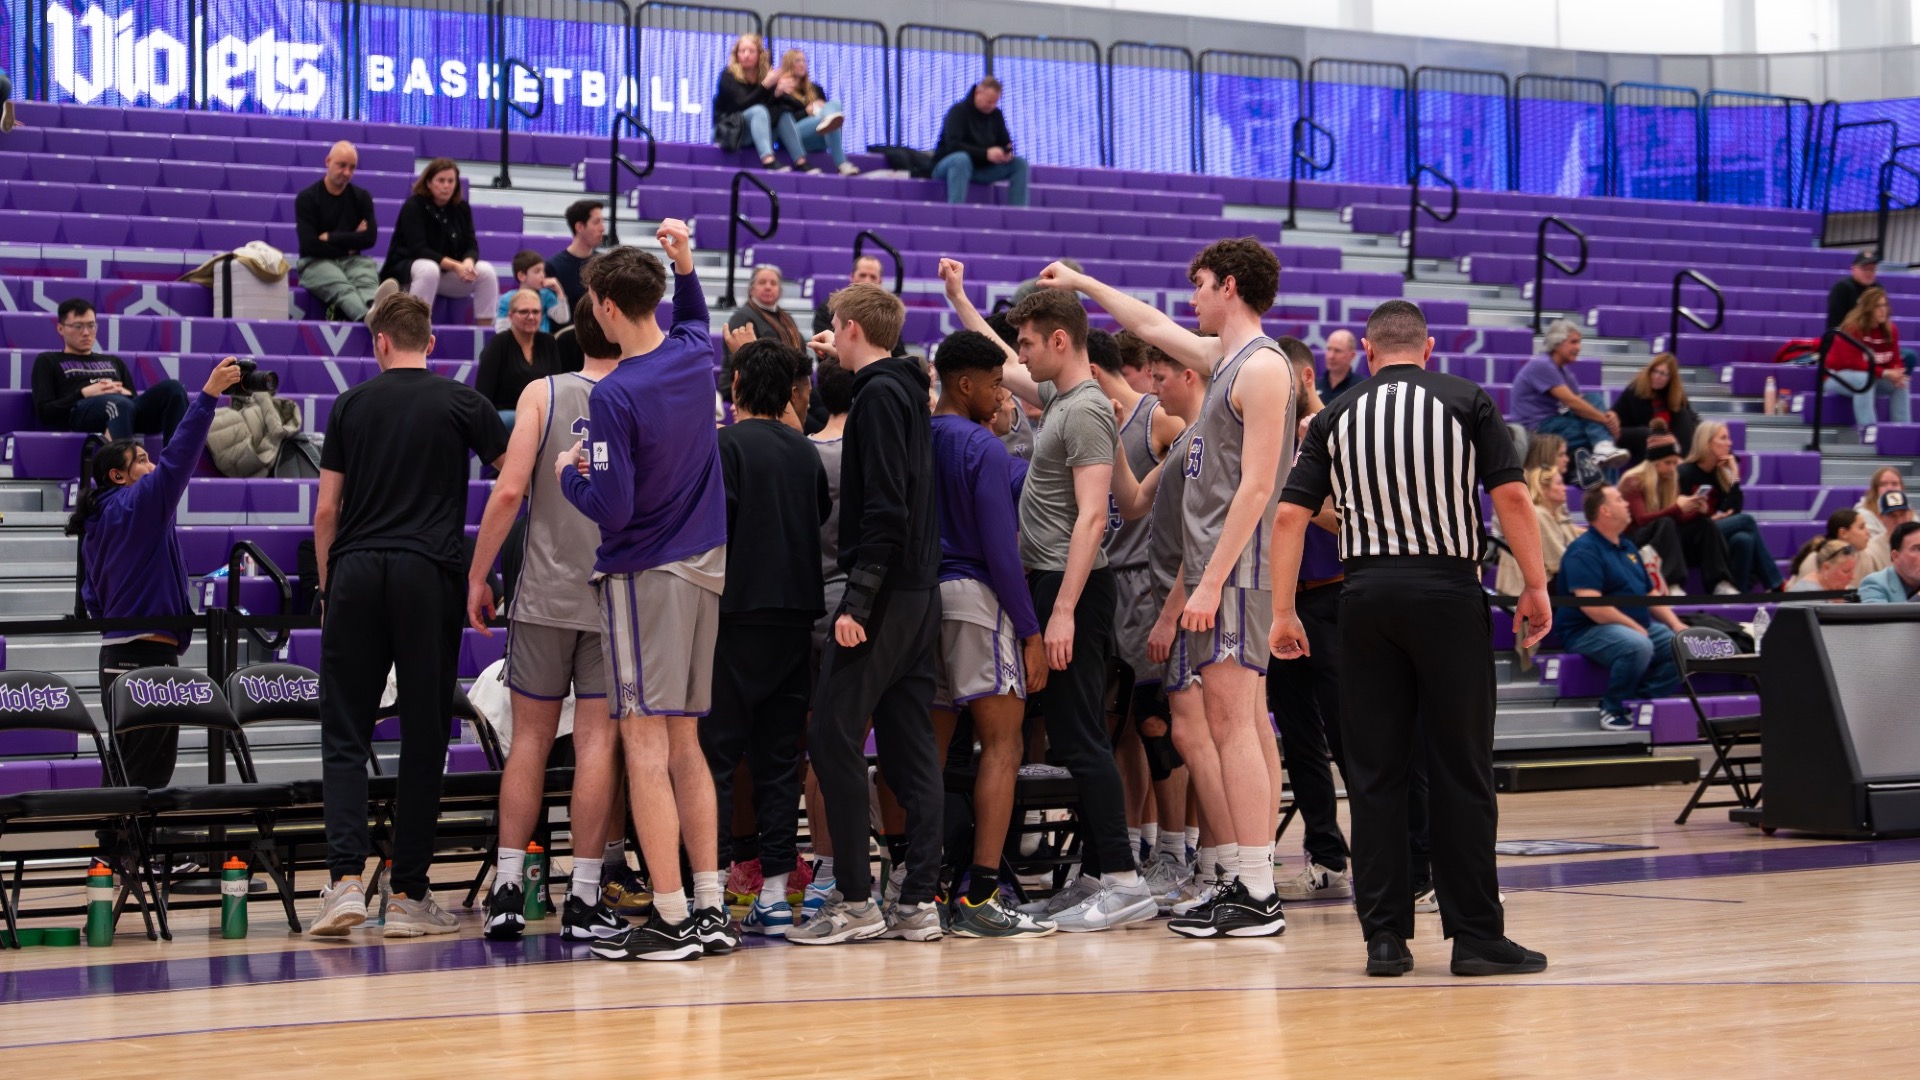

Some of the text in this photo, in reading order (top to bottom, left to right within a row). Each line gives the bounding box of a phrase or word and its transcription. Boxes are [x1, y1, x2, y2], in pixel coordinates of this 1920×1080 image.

[366, 54, 702, 114] BASKETBALL
[593, 462, 609, 471] NYU
[1683, 635, 1735, 658] Violets
[0, 683, 70, 712] iolets
[125, 677, 213, 708] Violets
[239, 674, 320, 704] Violets
